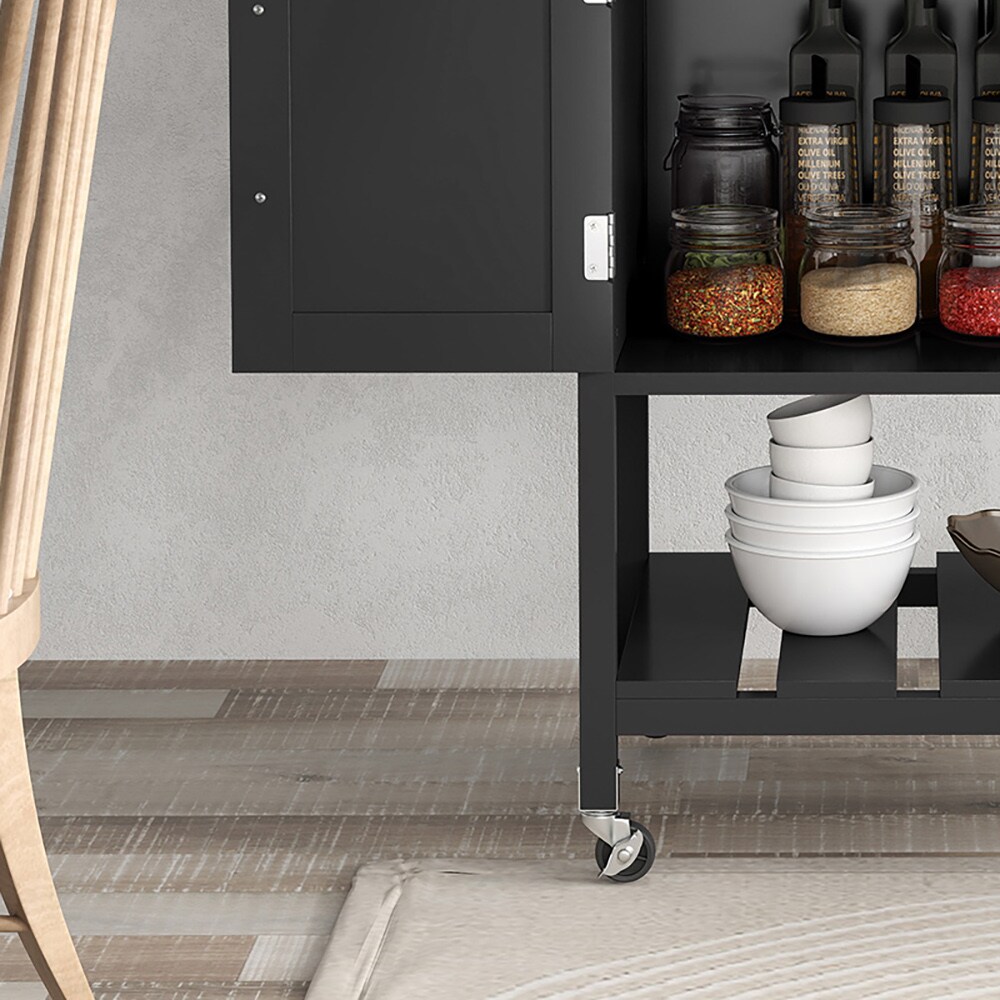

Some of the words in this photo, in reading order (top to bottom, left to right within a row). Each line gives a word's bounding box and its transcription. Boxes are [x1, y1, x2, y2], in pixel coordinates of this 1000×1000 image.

[798, 137, 824, 145] EXTRA
[825, 137, 849, 145] VIRGIN
[893, 137, 919, 145] EXTRA
[920, 137, 943, 145] VIRGIN
[798, 160, 840, 168] MILLENIUM
[893, 160, 935, 168] MILLENIUM
[798, 171, 821, 179] OLIVE
[823, 171, 845, 179] TREES
[893, 171, 916, 179] OLIVE
[918, 171, 940, 179] TREES
